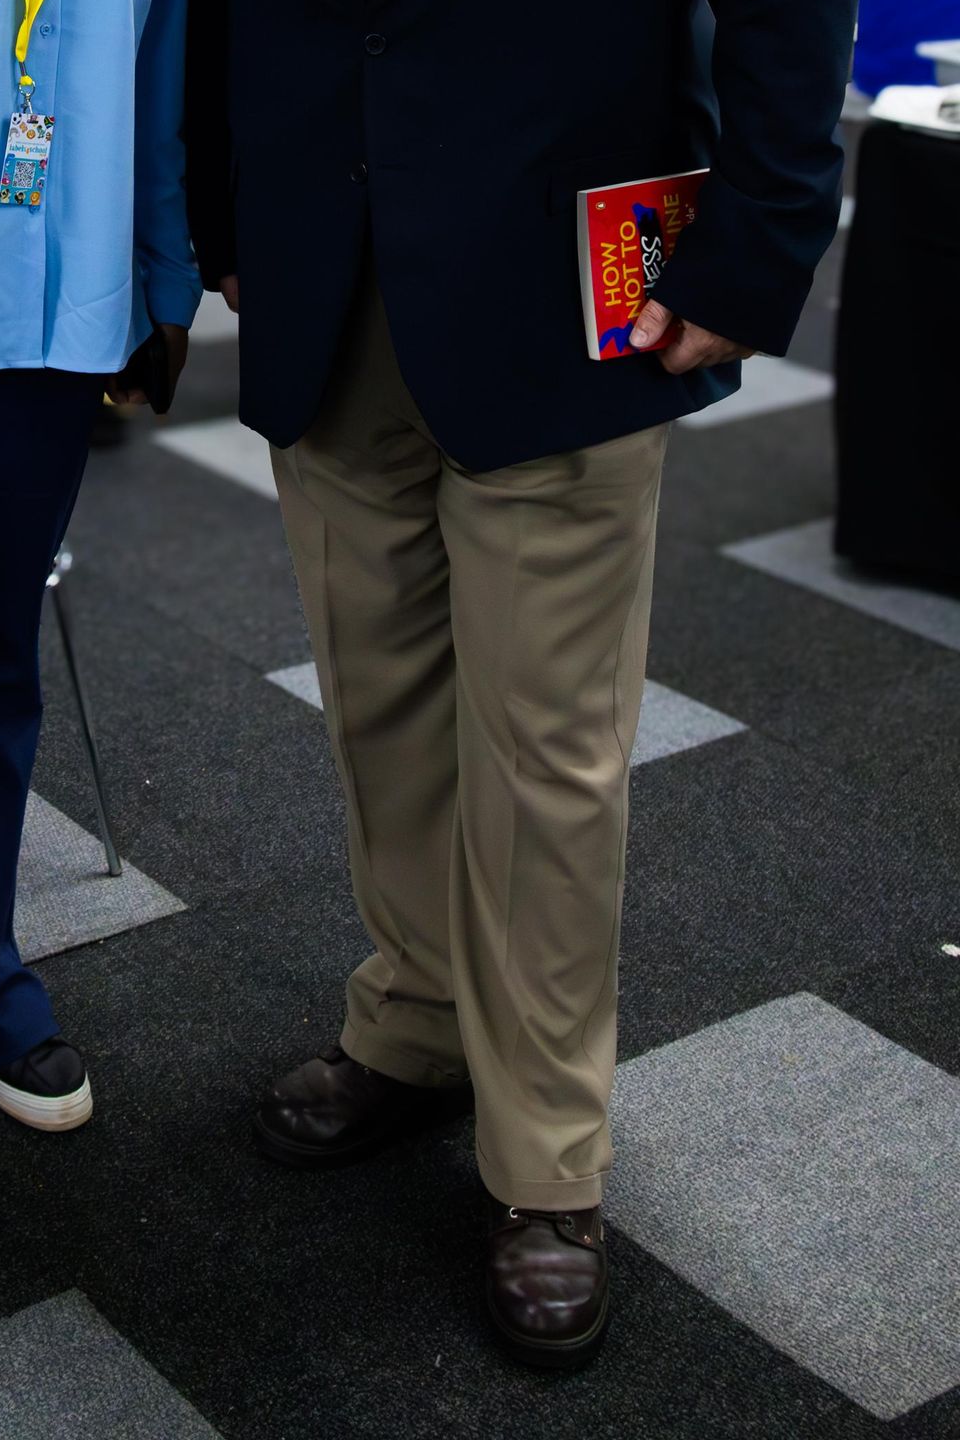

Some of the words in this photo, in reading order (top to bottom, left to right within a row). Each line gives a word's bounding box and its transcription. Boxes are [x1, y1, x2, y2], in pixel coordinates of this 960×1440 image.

[620, 221, 638, 258] TO
[641, 236, 662, 292] ESS
[601, 242, 621, 307] HOW
[622, 263, 641, 319] NOT
